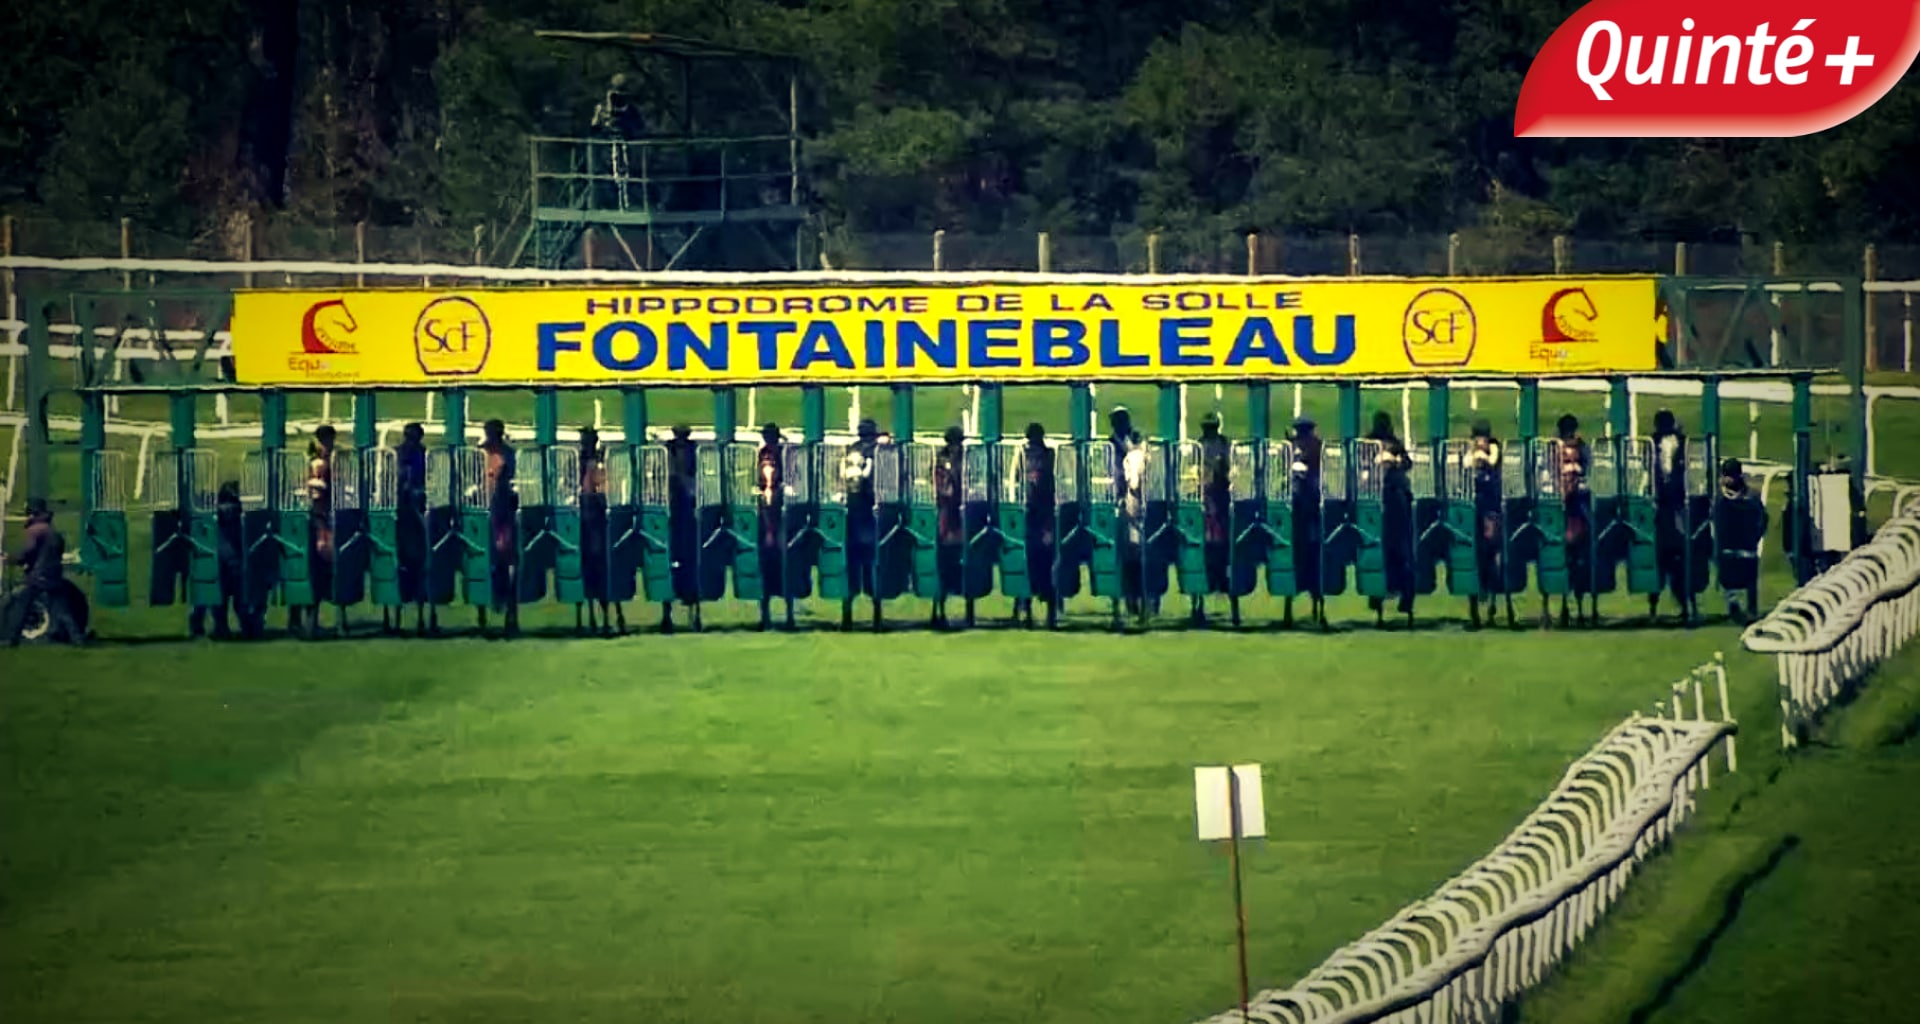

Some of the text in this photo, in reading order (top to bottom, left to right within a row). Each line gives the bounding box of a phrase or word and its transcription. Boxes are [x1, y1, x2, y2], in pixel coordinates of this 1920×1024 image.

[586, 291, 1303, 315] HIPPODROME DE LA SOLLE
[537, 314, 1356, 371] FONTAINEBLEAU
